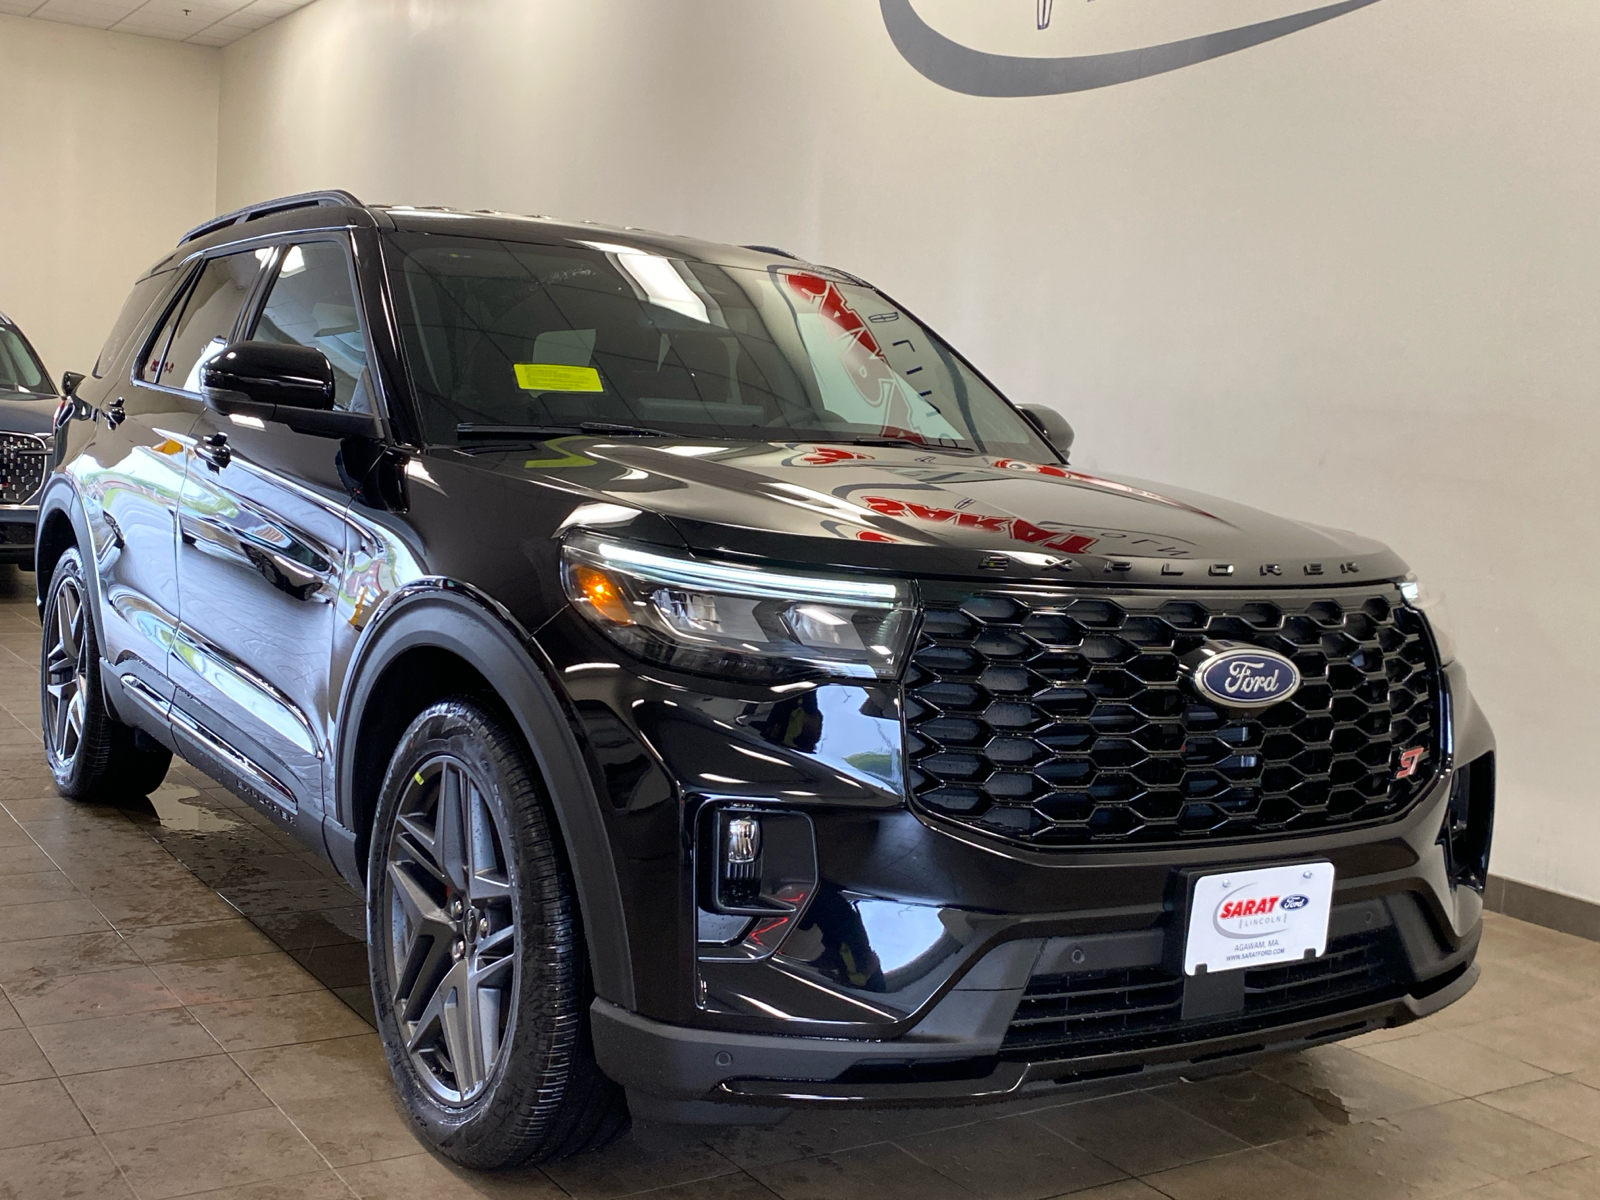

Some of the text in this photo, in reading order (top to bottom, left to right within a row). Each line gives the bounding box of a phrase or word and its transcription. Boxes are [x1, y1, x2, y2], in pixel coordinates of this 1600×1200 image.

[977, 556, 1359, 577] EXPLORER
[1225, 661, 1279, 694] Ford
[1396, 746, 1424, 779] ST
[1220, 895, 1280, 919] SARAT
[1245, 916, 1281, 927] LINCOLN
[1226, 947, 1285, 961] WWW.SARATFORD.COM
[1234, 939, 1279, 952] AGAWAM, MA
